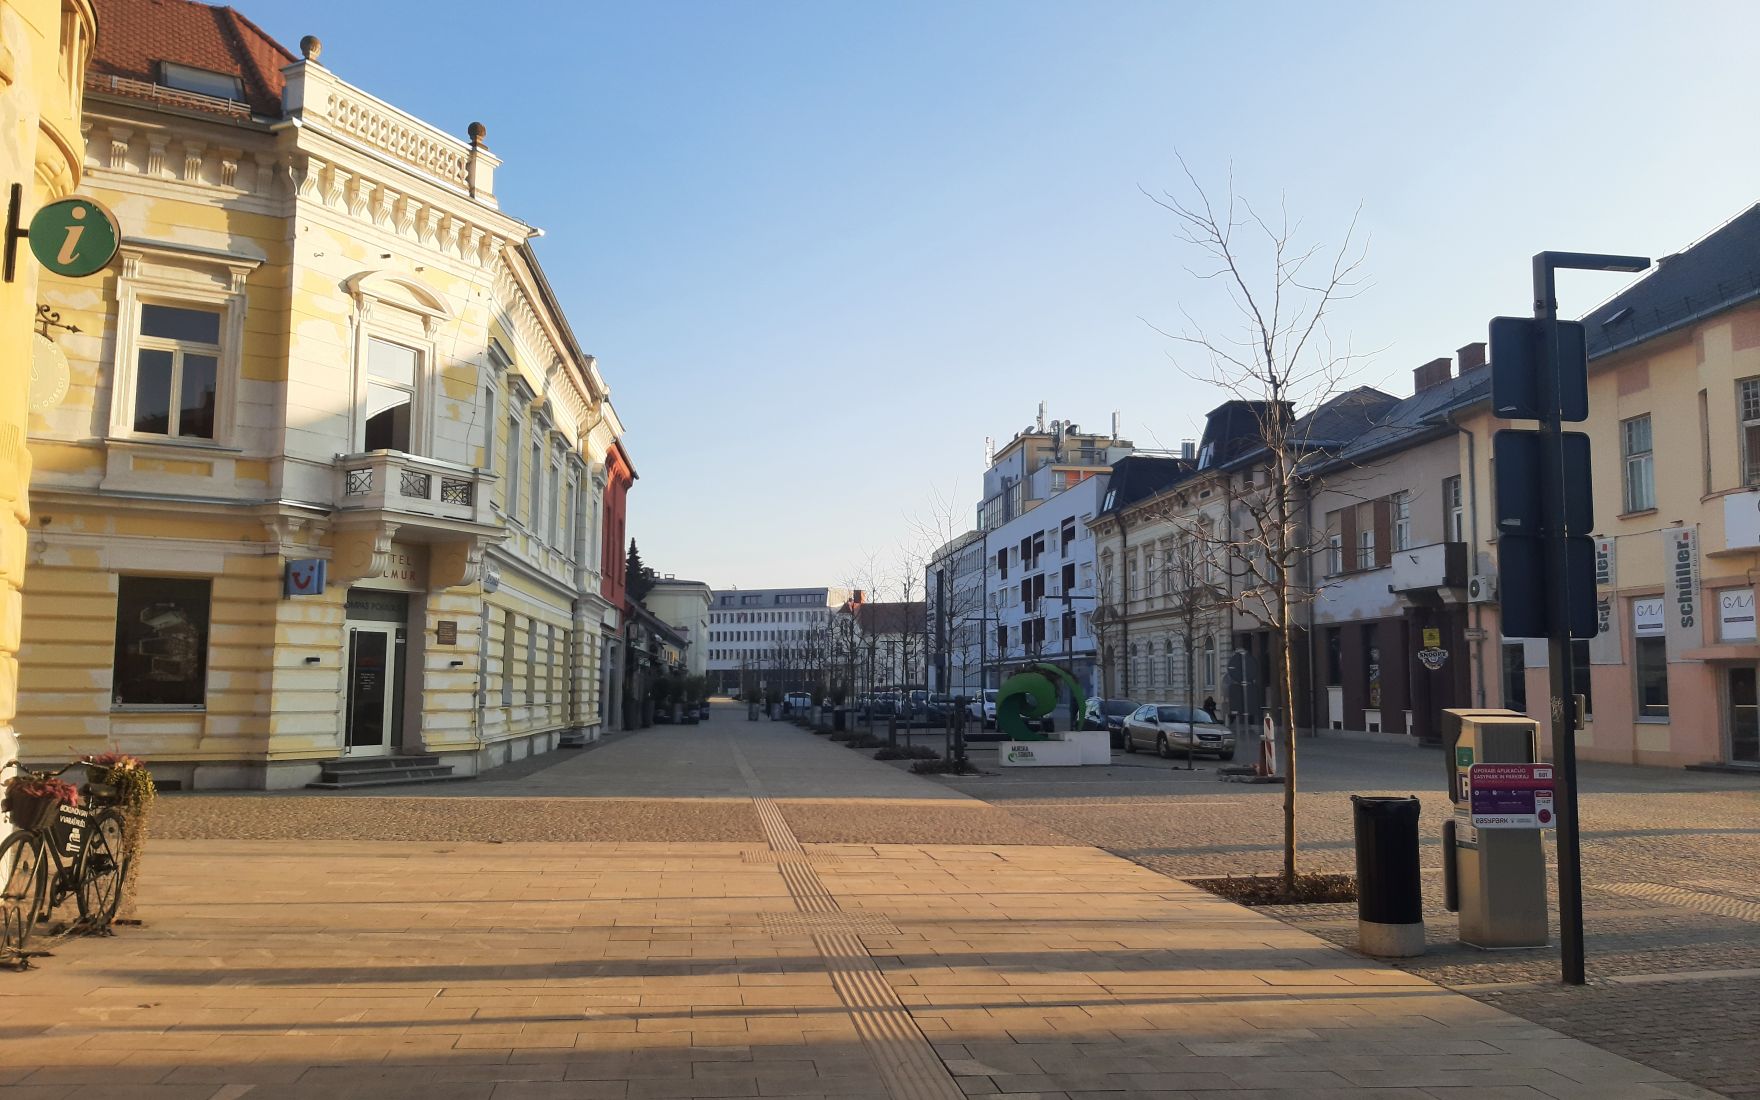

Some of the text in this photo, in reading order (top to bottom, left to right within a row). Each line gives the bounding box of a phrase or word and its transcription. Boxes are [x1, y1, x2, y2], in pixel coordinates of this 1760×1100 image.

[57, 206, 86, 266] i
[1675, 540, 1694, 629] schüller
[1723, 595, 1754, 609] GALA
[1636, 604, 1663, 617] GALA
